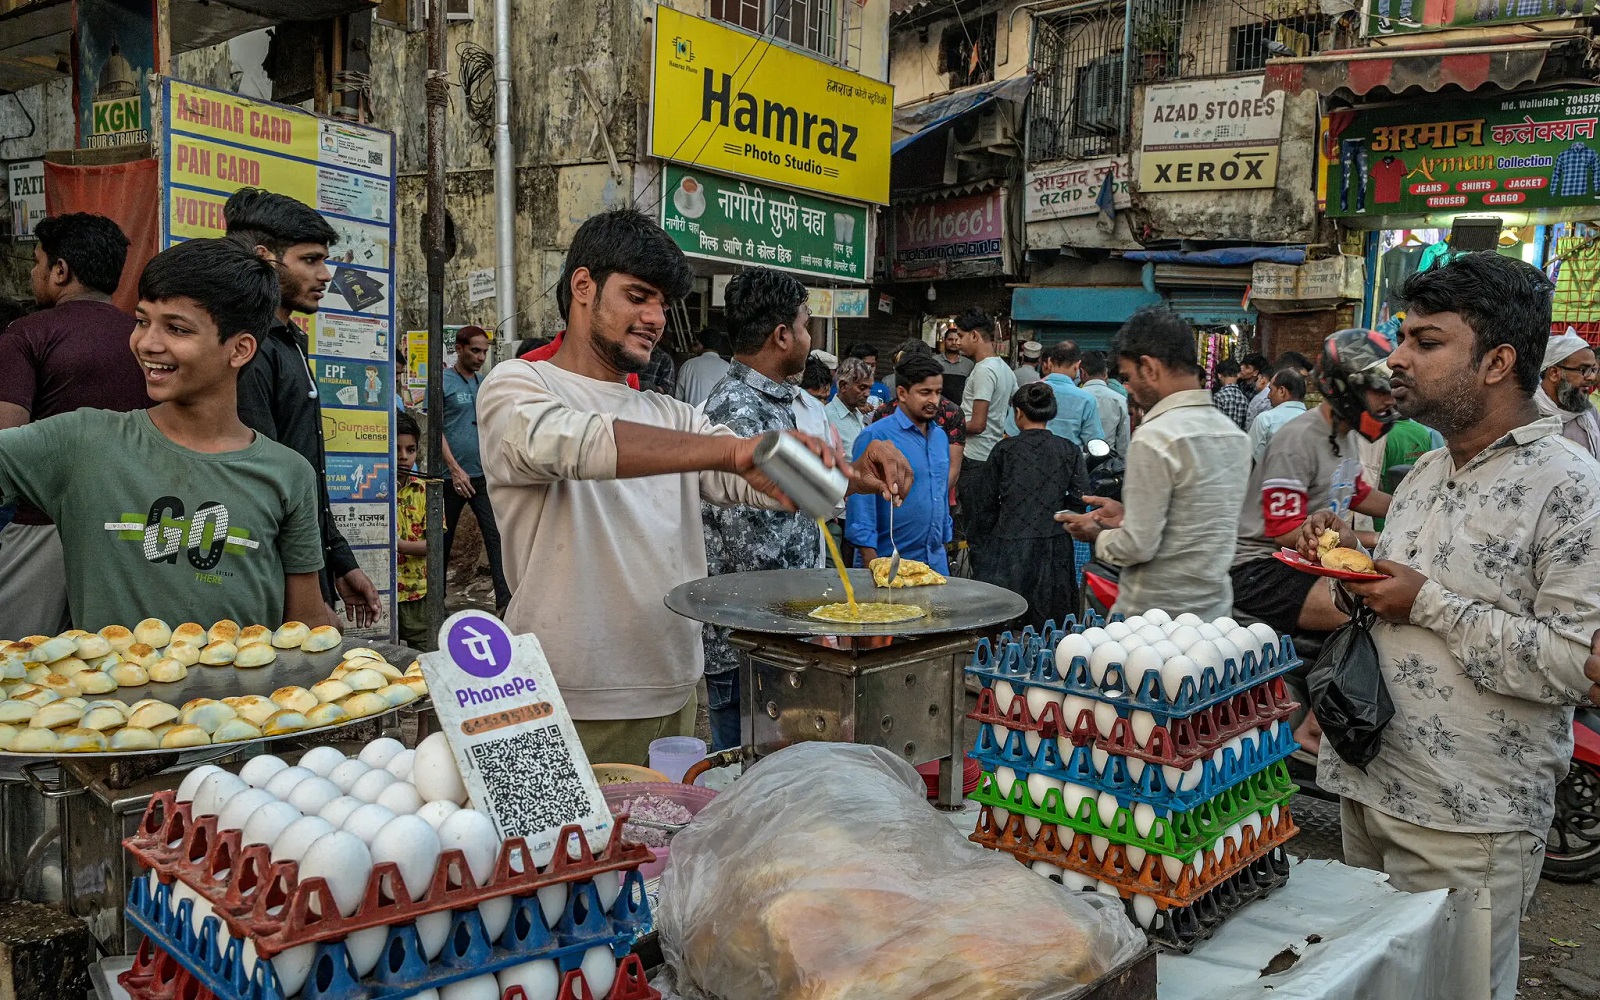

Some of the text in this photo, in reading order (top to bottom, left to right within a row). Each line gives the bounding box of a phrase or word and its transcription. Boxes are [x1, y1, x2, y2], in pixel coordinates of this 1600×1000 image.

[701, 67, 859, 162] Hamraz
[1153, 97, 1276, 123] AZAD STORES
[1501, 102, 1516, 111] Md.
[1520, 97, 1559, 109] Waliullah
[1565, 104, 1600, 116] 932677
[94, 100, 141, 134] KGN
[176, 93, 245, 134] AADHAR
[249, 111, 293, 145] CARD
[87, 129, 149, 149] TOUR & TRAVELS
[1371, 115, 1598, 152] अरमान कलेक्शन
[176, 144, 260, 187] PAN CARD
[744, 143, 822, 176] Photo Studio
[1153, 159, 1264, 184] XEROX
[1407, 153, 1552, 181] Arman Collection
[1040, 188, 1083, 207] AZAD
[1416, 178, 1542, 193] JEANS SHIRTS JACKET
[717, 182, 826, 238] नागौरी सुफी चहा
[1429, 193, 1519, 206] TROUSER CARGO
[666, 215, 700, 234] नागौरी चहा
[699, 230, 718, 252] मिल्क
[723, 237, 743, 256] आणि
[745, 239, 754, 257] टी
[757, 240, 776, 259] कोल्ड
[325, 364, 346, 379] EPF
[338, 421, 387, 433] Gumasta
[355, 432, 387, 441] License
[1270, 492, 1301, 517] 23
[143, 495, 229, 571] GO
[195, 572, 223, 585] THERE
[461, 625, 497, 666] पे
[455, 676, 537, 708] PhonePe
